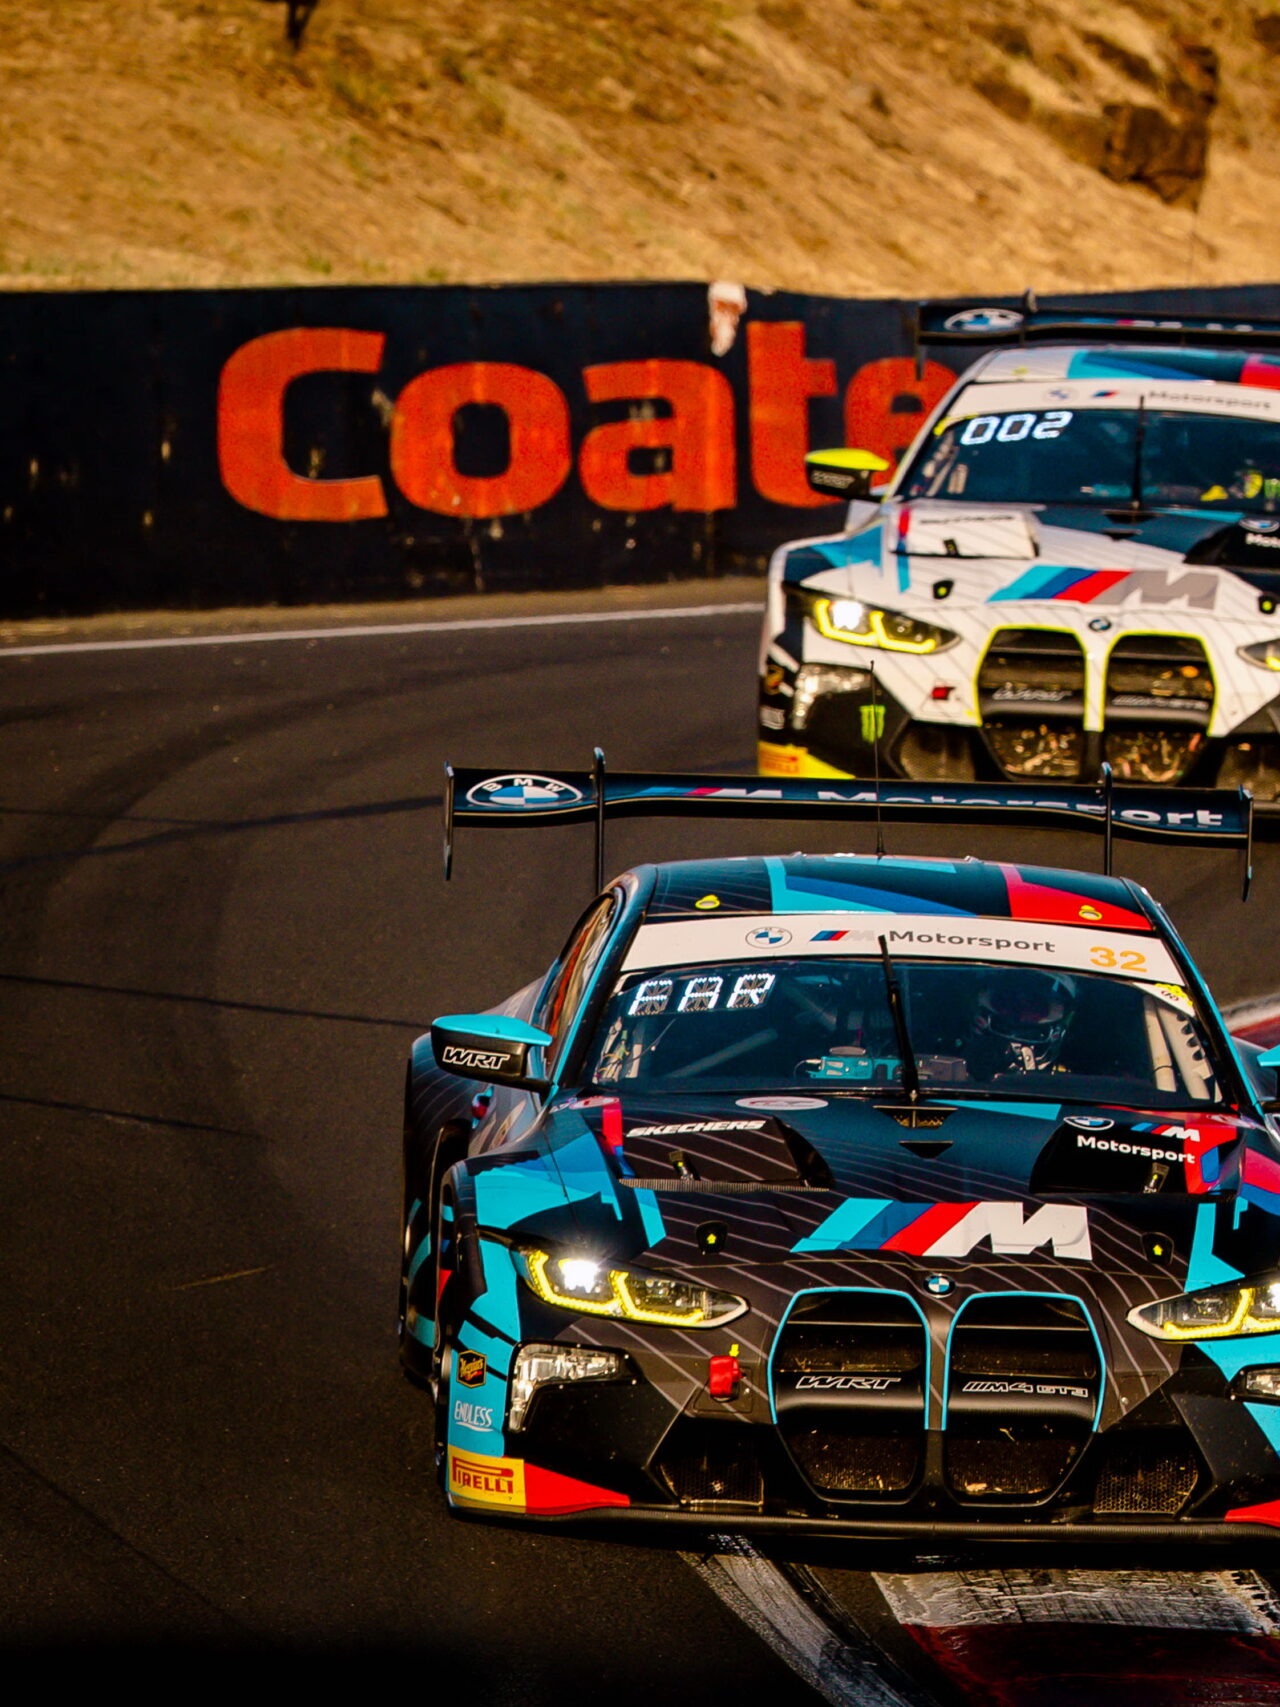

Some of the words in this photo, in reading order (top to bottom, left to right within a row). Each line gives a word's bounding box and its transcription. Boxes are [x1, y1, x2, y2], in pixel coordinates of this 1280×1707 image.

[217, 321, 960, 522] Coate
[960, 411, 1074, 445] 002
[888, 930, 1056, 953] Motorsport
[1089, 946, 1148, 973] 32
[628, 973, 776, 1016] FAR
[442, 1046, 511, 1070] WRT
[625, 1119, 767, 1138] SKECHERS
[1077, 1134, 1196, 1164] Motorsport
[921, 1201, 1093, 1261] M
[795, 1375, 902, 1390] WRT
[454, 1400, 494, 1428] ENDLESS
[452, 1456, 514, 1495] PIRELLI
